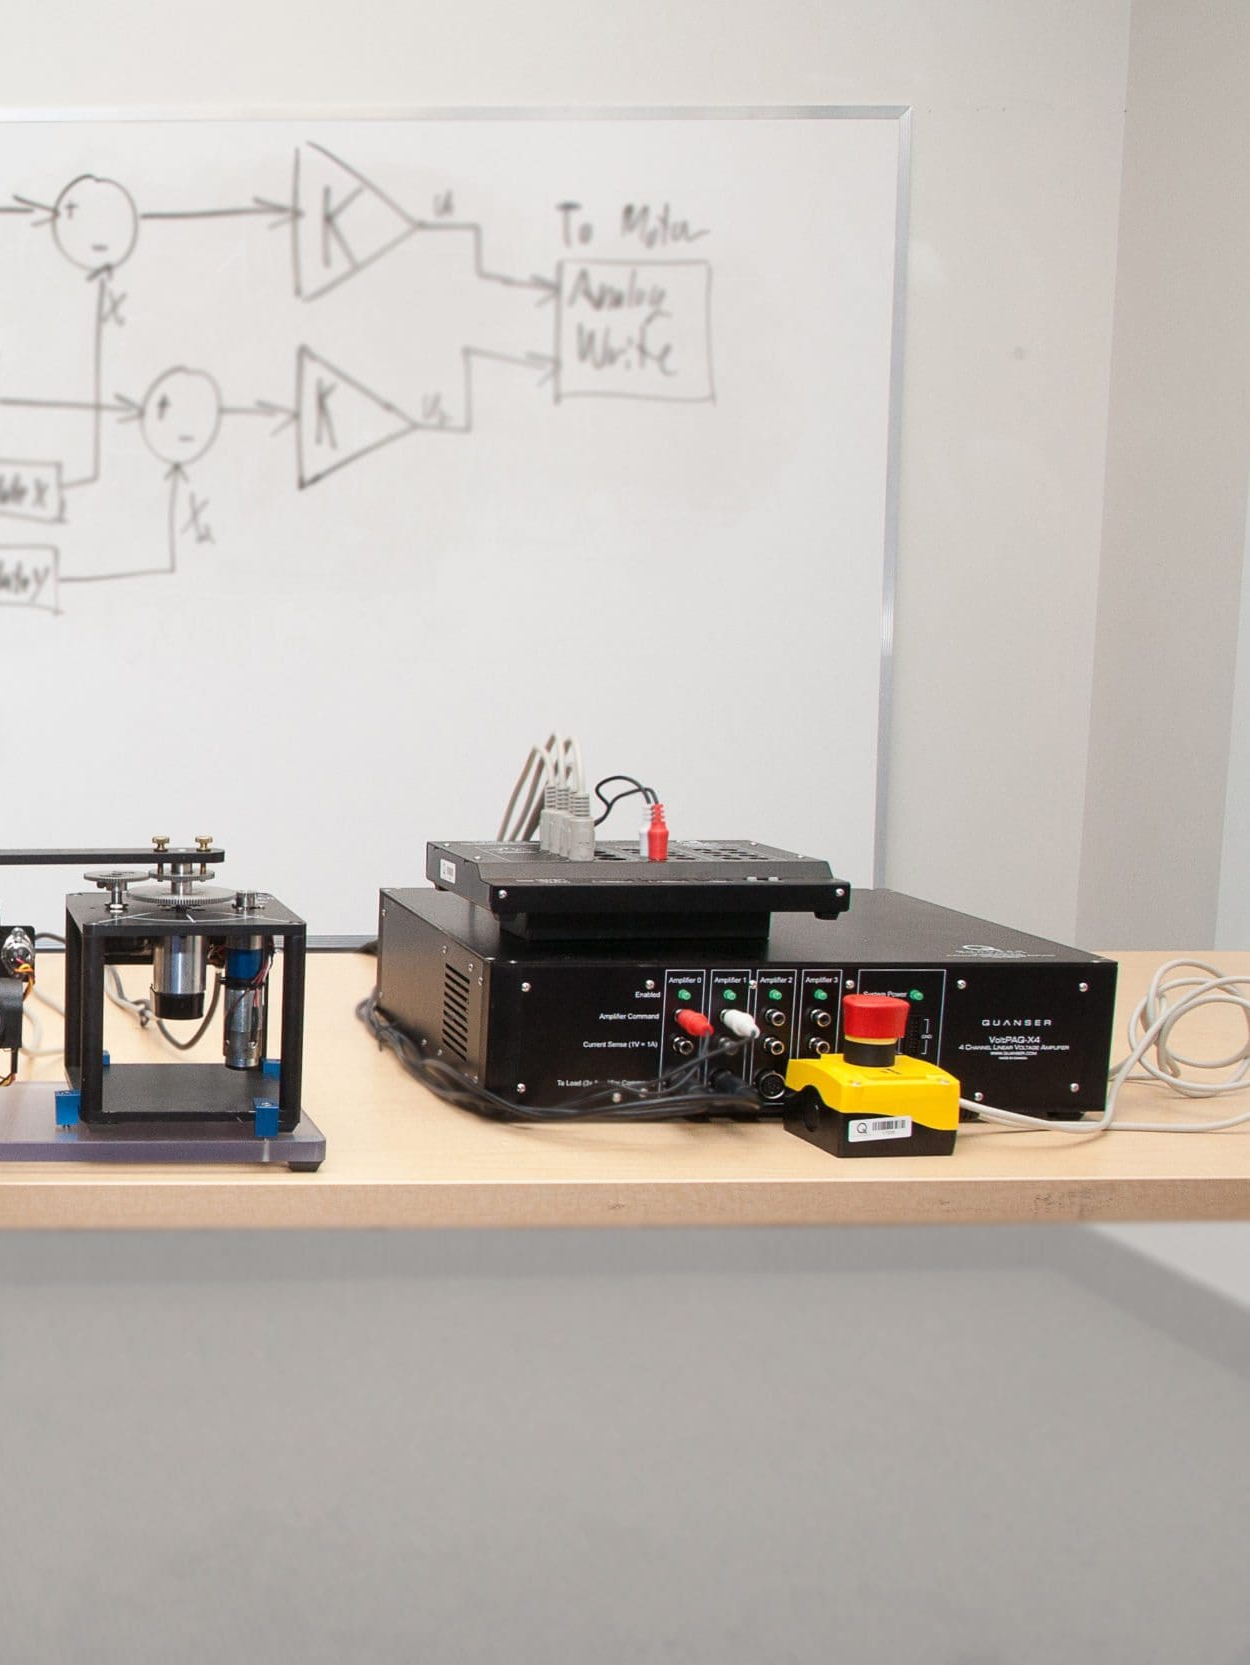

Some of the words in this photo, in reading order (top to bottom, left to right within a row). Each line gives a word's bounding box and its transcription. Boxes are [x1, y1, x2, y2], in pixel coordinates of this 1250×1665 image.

[321, 186, 363, 268] K
[557, 202, 593, 248] To
[569, 268, 667, 311] Analog
[575, 309, 677, 376] Write
[315, 376, 337, 449] K
[668, 976, 695, 985] Amplifier
[696, 976, 702, 984] 0
[714, 976, 741, 985] Amplifier
[743, 976, 747, 984] 1
[759, 976, 786, 985] Amplifier
[787, 976, 793, 984] 2
[805, 976, 831, 985] Amplifier
[833, 976, 839, 984] 3
[599, 1013, 627, 1021] Amplifier
[557, 1079, 565, 1087] To
[566, 1079, 582, 1087] Load
[857, 1122, 867, 1134] Q
